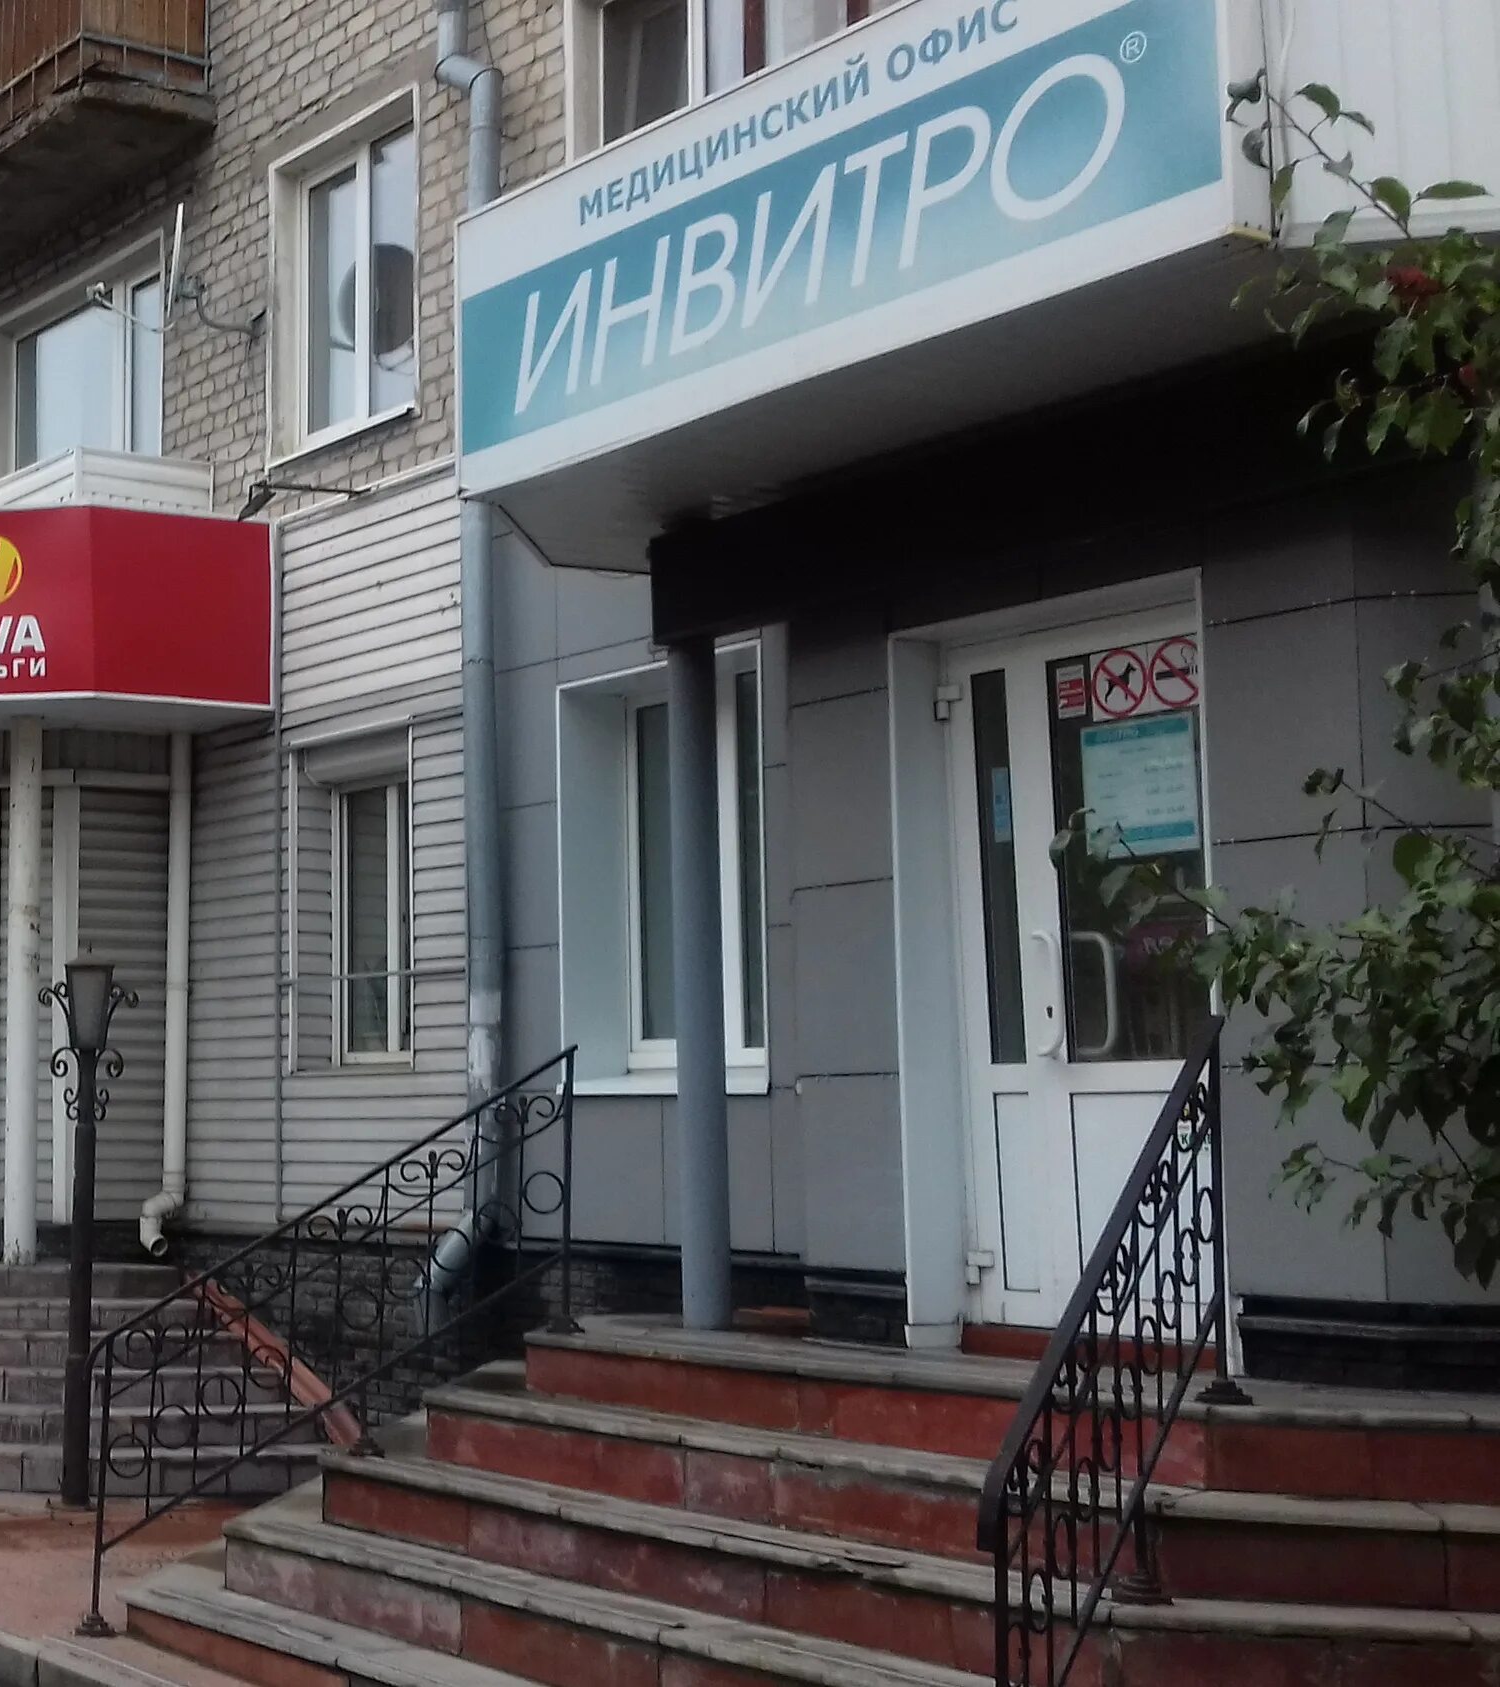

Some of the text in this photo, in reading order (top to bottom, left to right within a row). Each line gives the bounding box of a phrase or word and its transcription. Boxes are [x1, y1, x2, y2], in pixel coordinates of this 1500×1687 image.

[513, 54, 1126, 416] ИНВИТРО
[579, 0, 1018, 226] МЕДИЦИНСКИЙ ОФИС
